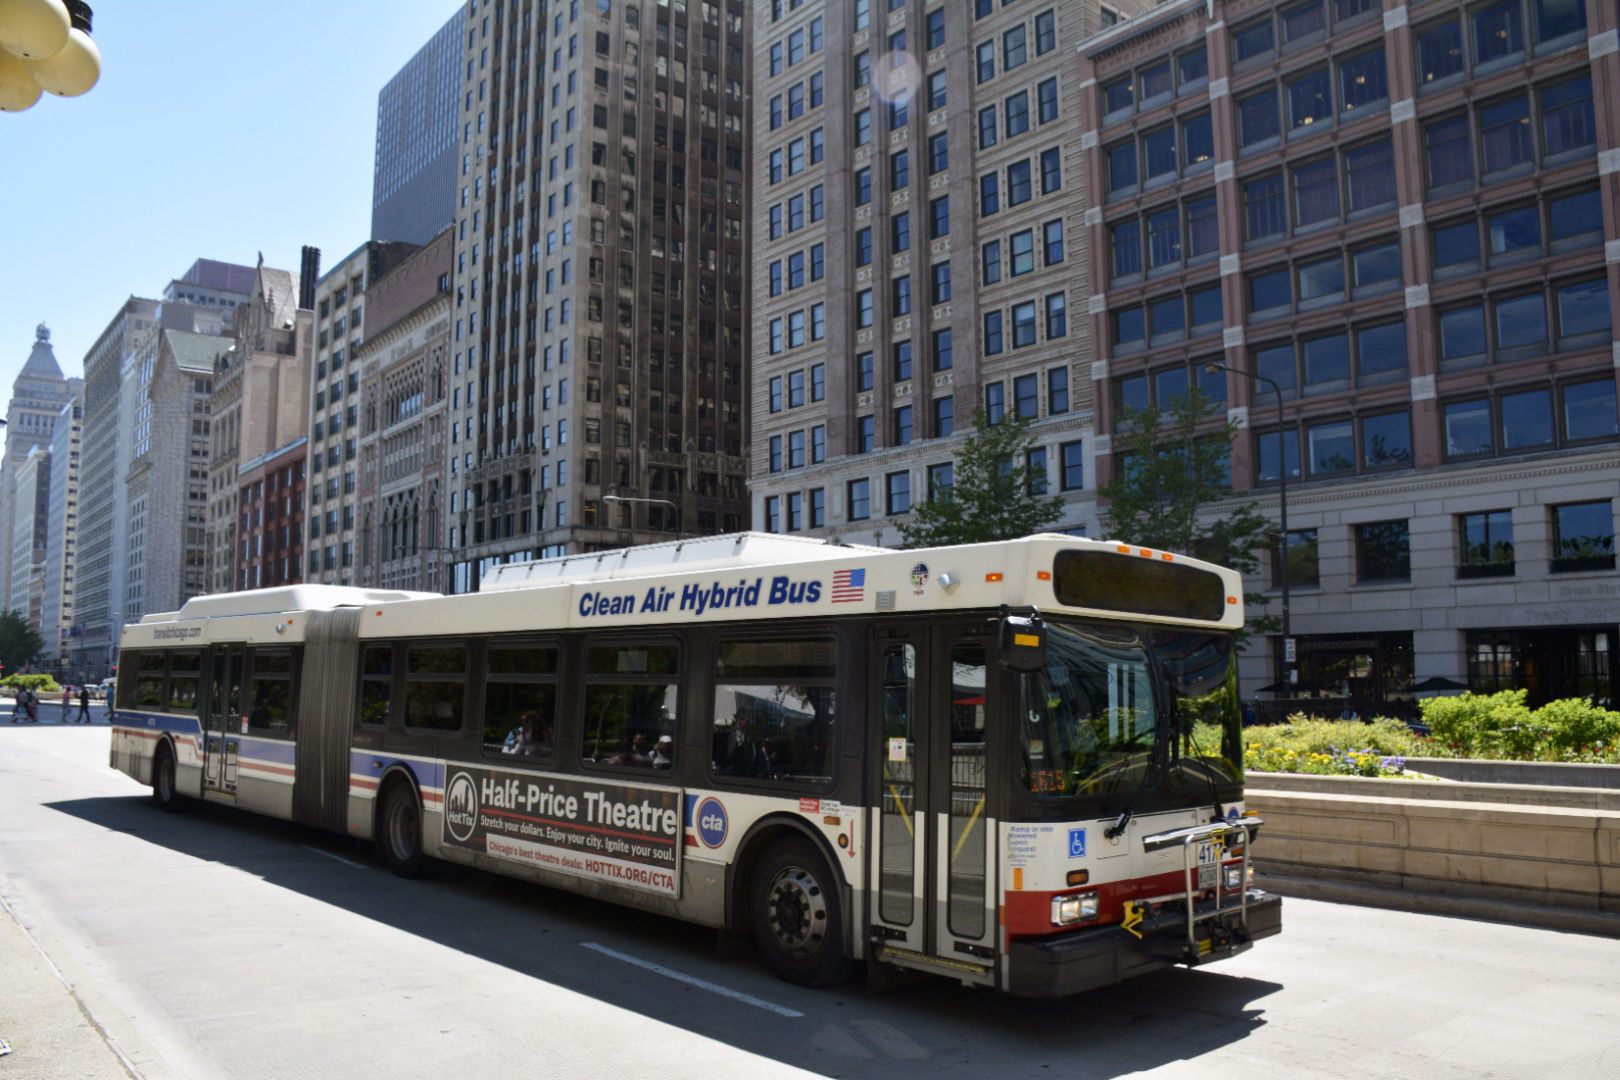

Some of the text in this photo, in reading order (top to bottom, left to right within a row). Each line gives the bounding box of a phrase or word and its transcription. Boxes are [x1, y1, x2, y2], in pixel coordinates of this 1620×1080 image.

[579, 576, 822, 617] Clean Air Hybrid Bus
[481, 777, 678, 836] Half-Price Theatre
[702, 814, 723, 832] cta
[480, 815, 675, 861] Stretch your dollars. Enjoy your city. Ignite your soul.
[489, 841, 675, 891] Chicago's best theatre deals: HOTTIX.ORG/CTA
